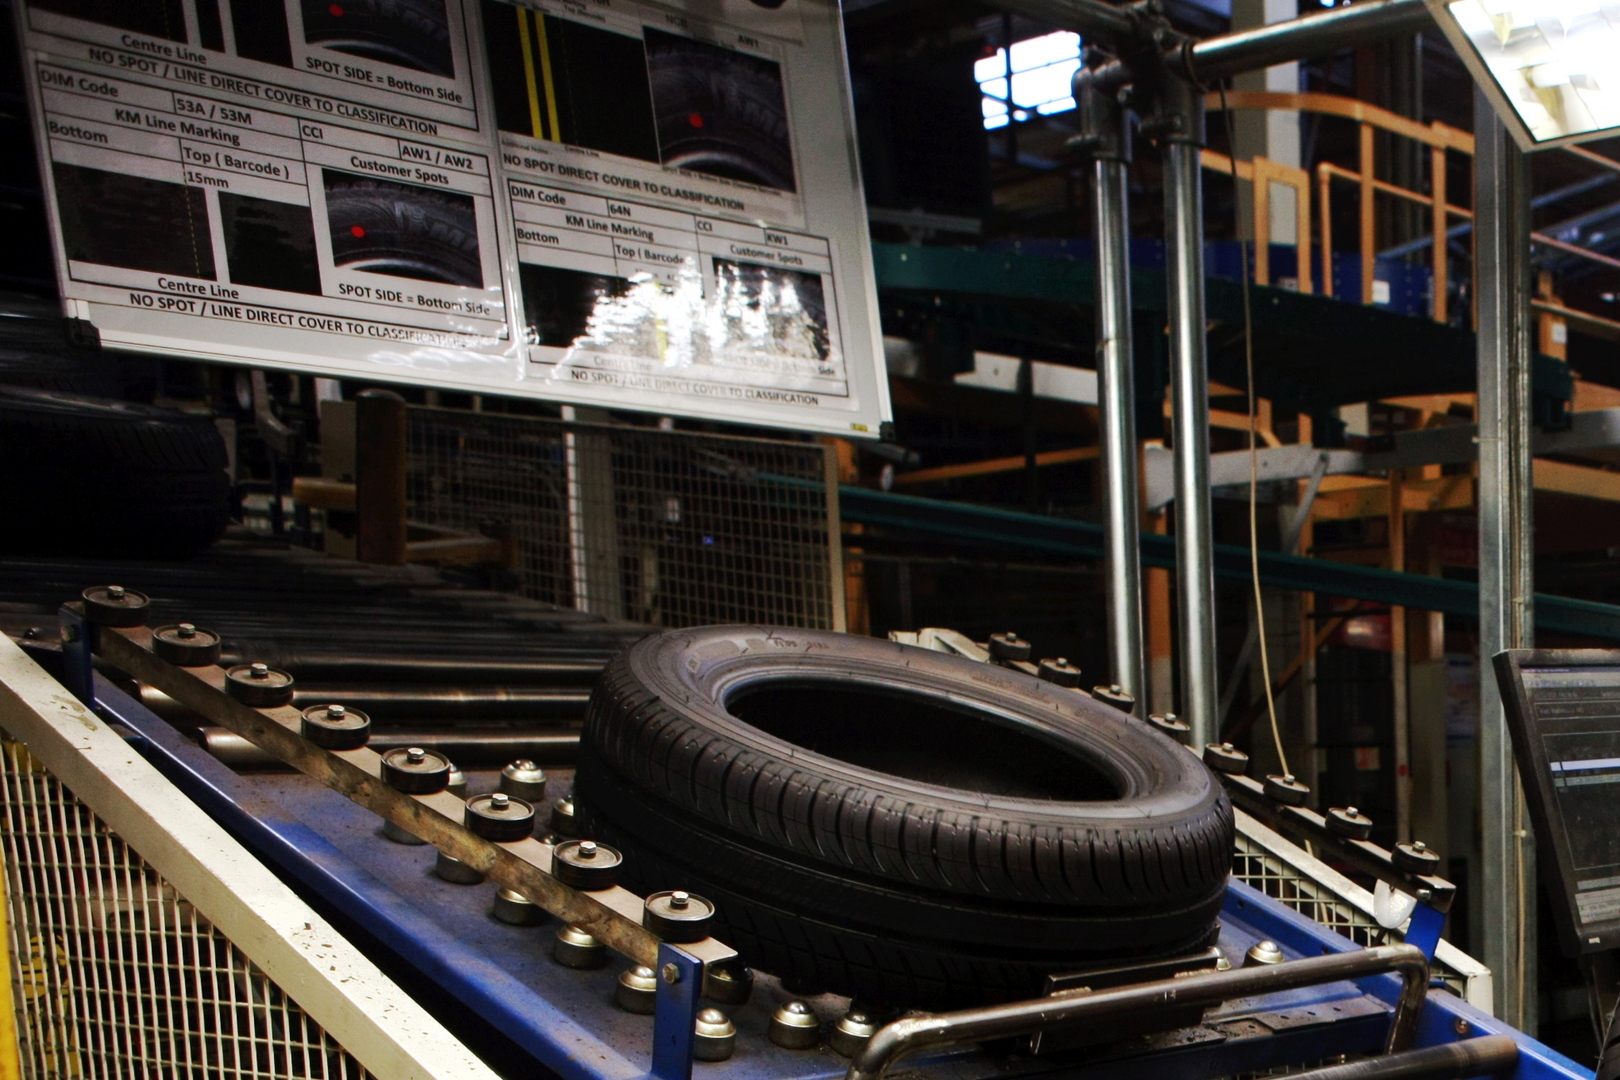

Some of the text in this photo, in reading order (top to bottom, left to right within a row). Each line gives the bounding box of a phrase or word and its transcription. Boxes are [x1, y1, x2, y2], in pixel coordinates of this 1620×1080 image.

[122, 34, 207, 65] Centre Line
[41, 69, 119, 97] DIM Code
[89, 49, 115, 65] NO
[119, 56, 158, 74] SPOT
[175, 67, 207, 85] LINE
[211, 76, 261, 97] DIRECT
[265, 86, 311, 107] COVER
[314, 99, 334, 113] TO
[337, 103, 438, 136] CLASSIFICATION
[306, 56, 340, 75] SPOT
[344, 66, 373, 82] SIDE
[388, 76, 433, 97] Bottom
[437, 86, 463, 103] Side
[176, 98, 206, 115] 53A
[220, 108, 252, 125] 53M
[49, 120, 109, 144] Bottom
[115, 108, 241, 146] KM Line Marking
[183, 146, 212, 165] Top
[224, 154, 281, 178] Barcode
[351, 156, 449, 186] Customer Spots
[402, 144, 432, 162] AW1
[445, 154, 473, 170] AW2
[187, 170, 229, 189] 15mm
[503, 153, 521, 167] NO
[524, 158, 555, 173] SPOT
[558, 164, 600, 182] DIRECT
[602, 172, 640, 192] COVER
[643, 181, 658, 194] TO
[660, 184, 745, 211] CLASSIFICATION
[510, 185, 566, 206] DIM Code
[610, 203, 632, 217] 64N
[516, 228, 559, 245] Bottom
[565, 215, 654, 243] KM Line Marking
[615, 244, 635, 258] Top
[644, 249, 685, 264] Barcode
[730, 244, 804, 266] Customer Spots
[158, 277, 239, 299] Centre Line
[338, 283, 371, 299] SPOT
[375, 289, 403, 303] SIDE
[417, 294, 462, 311] Bottom
[466, 302, 490, 316] Side
[130, 292, 154, 307] NO
[157, 296, 196, 312] SPOT
[211, 304, 242, 319] LINE
[246, 308, 294, 326] DIRECT
[298, 316, 344, 332] COVER
[347, 322, 364, 335] TO
[571, 370, 588, 381] NO
[591, 371, 619, 384] SPOT
[655, 380, 690, 392] DIRECT
[729, 387, 742, 397] TO
[745, 389, 819, 405] CLASSIFICATION
